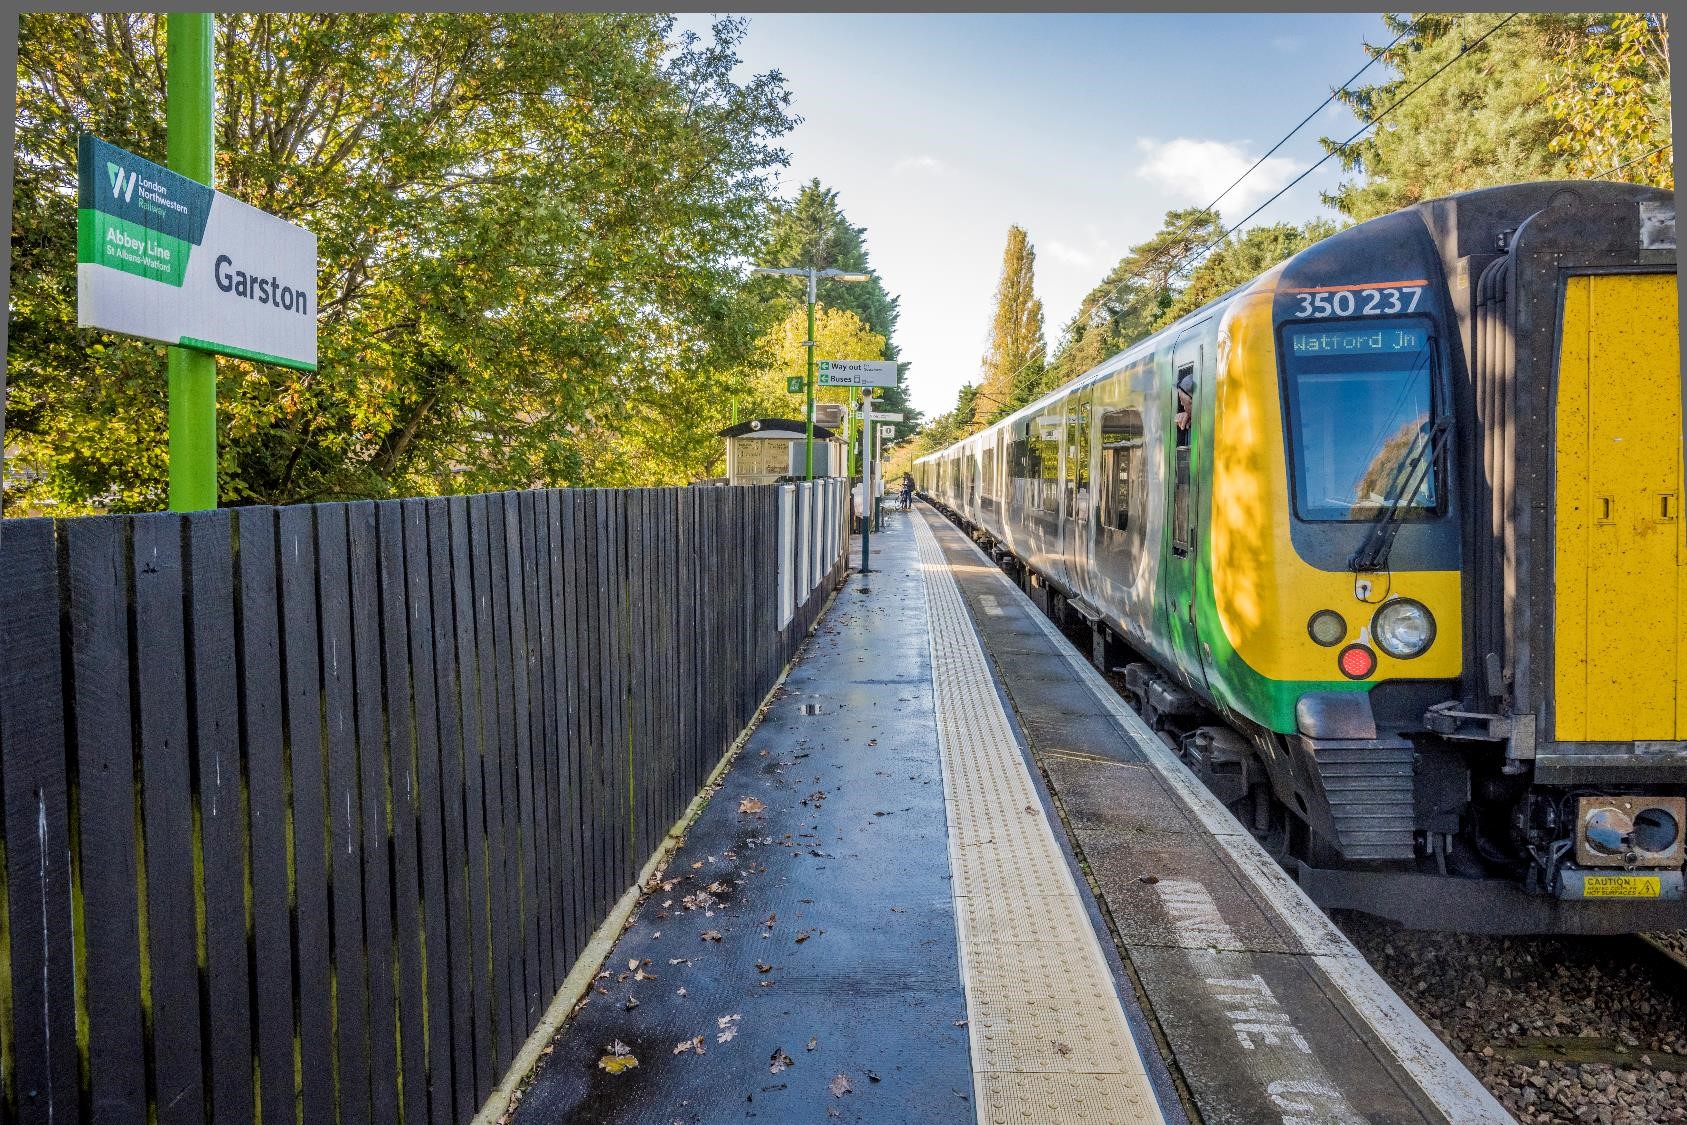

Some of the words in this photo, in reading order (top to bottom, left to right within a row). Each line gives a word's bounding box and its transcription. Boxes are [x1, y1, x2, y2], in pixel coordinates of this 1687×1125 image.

[138, 174, 168, 196] London
[138, 186, 189, 215] Northwestern
[138, 198, 168, 219] Railway
[106, 227, 145, 255] Abbey
[147, 240, 171, 260] Line
[106, 244, 116, 256] St
[116, 249, 172, 273] Albans-Watford
[214, 253, 308, 316] Garston
[1294, 290, 1356, 318] 350
[1361, 286, 1422, 315] 237
[1293, 332, 1382, 351] Watford
[1392, 330, 1415, 349] Jn
[830, 375, 852, 383] Buses
[831, 362, 847, 372] Way
[1587, 878, 1631, 886] CAUTION
[1204, 974, 1311, 1053] THE
